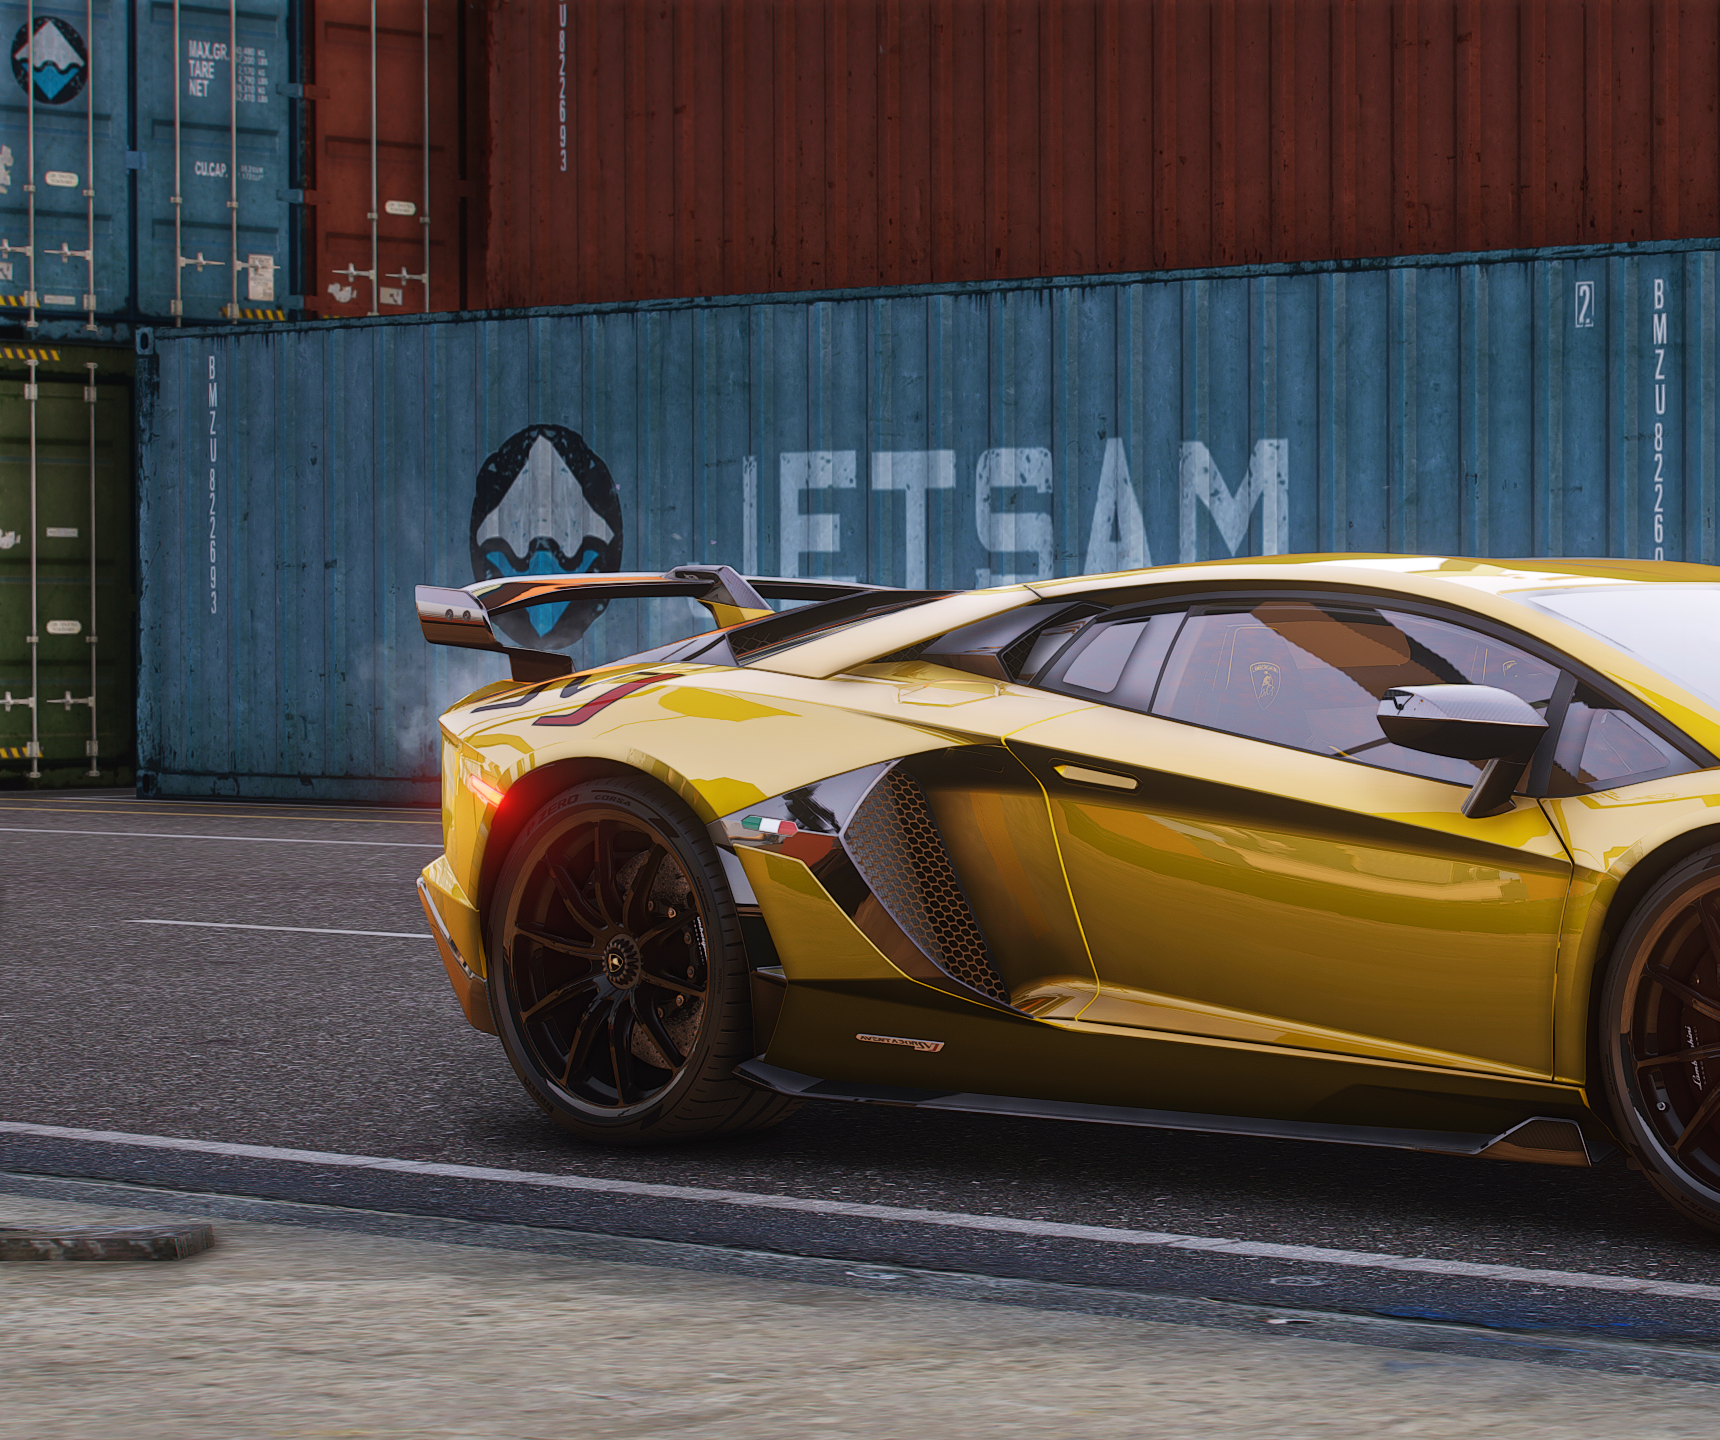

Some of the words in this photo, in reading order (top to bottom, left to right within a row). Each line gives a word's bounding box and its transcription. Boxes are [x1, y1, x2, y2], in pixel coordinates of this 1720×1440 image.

[188, 39, 230, 61] MAX.GR.
[188, 59, 215, 79] TARE
[188, 79, 209, 97] NET
[194, 161, 228, 178] CU.CAP.
[1578, 284, 1591, 325] 2
[594, 794, 631, 807] CORSA
